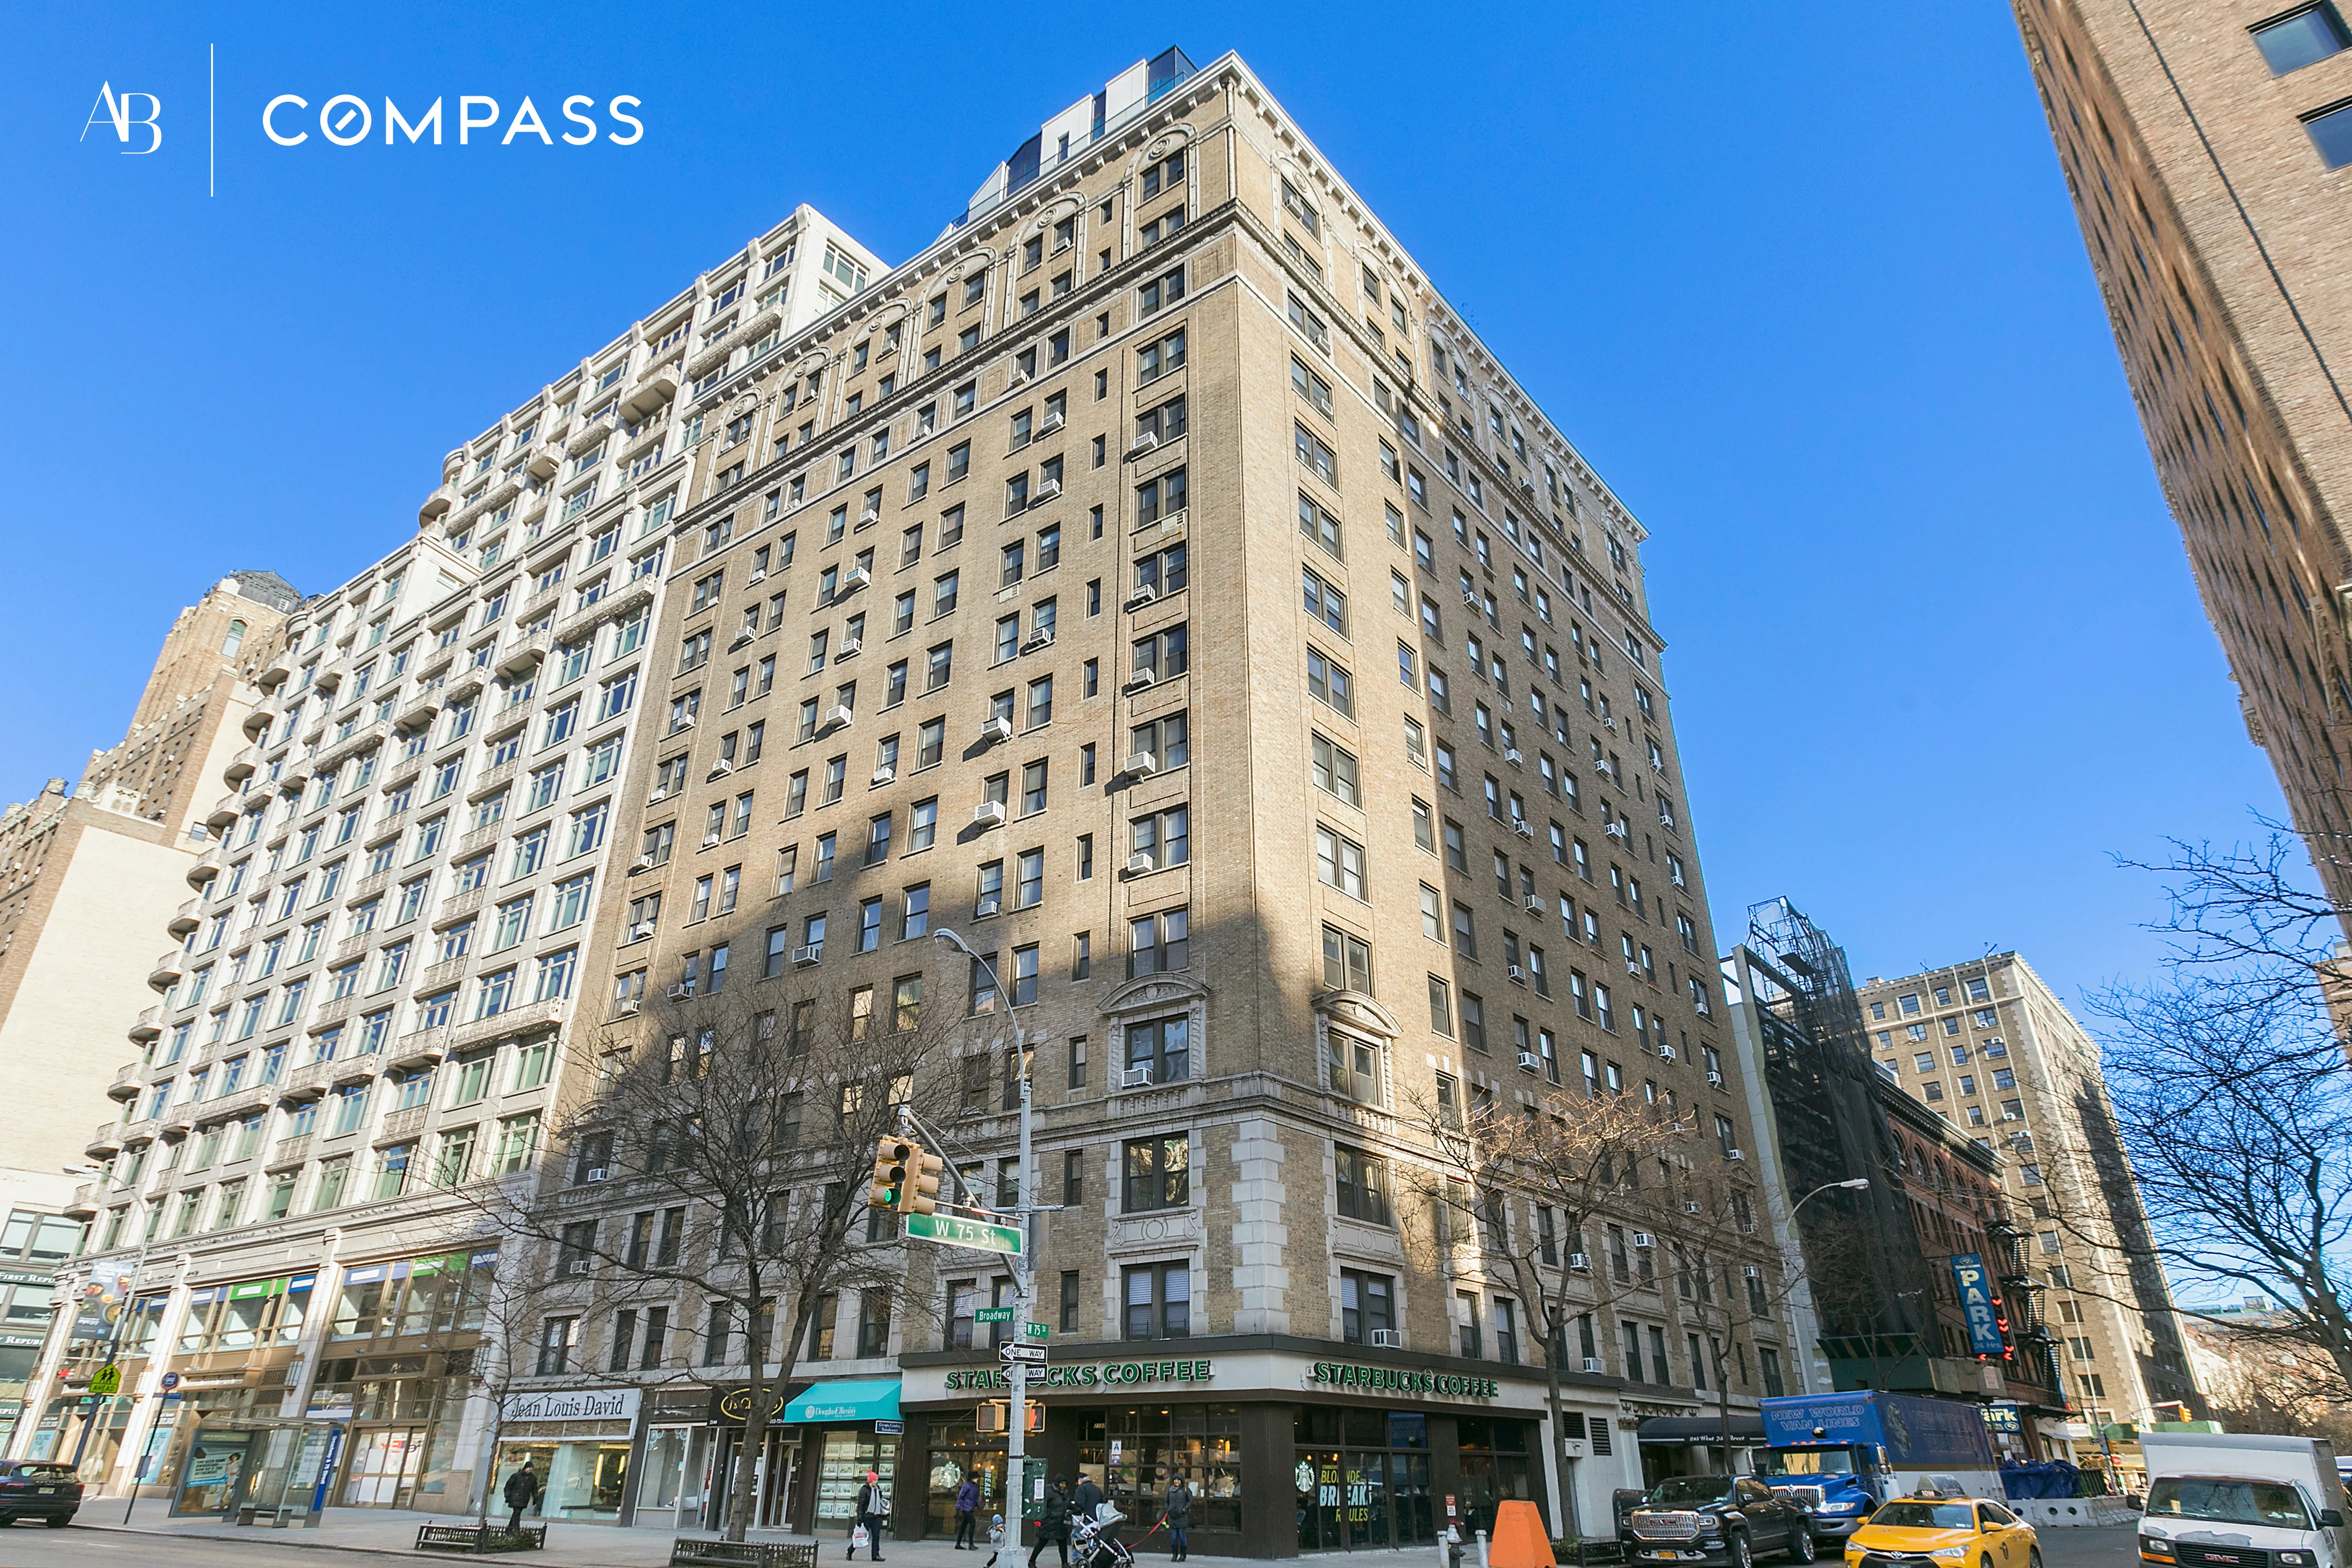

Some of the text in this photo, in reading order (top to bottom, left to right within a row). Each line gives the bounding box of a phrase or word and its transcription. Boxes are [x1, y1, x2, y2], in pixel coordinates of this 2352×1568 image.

[935, 1219, 996, 1245] W 75 St
[27, 1274, 57, 1284] REPU
[1960, 1270, 1996, 1341] PARK
[979, 1310, 1010, 1321] Broadway
[1027, 1323, 1032, 1334] W
[1034, 1324, 1041, 1335] 75
[946, 1360, 1210, 1390] STARCKS COFFEE
[1315, 1361, 1499, 1397] STARBUCKS COFFEE
[512, 1394, 625, 1418] Jean Louis David
[1772, 1405, 1864, 1421] NEW WORLD
[1780, 1417, 1860, 1431] VAN LINES
[327, 1435, 338, 1458] Broadway
[320, 1470, 329, 1484] Street
[2205, 1553, 2239, 1563] GMC
